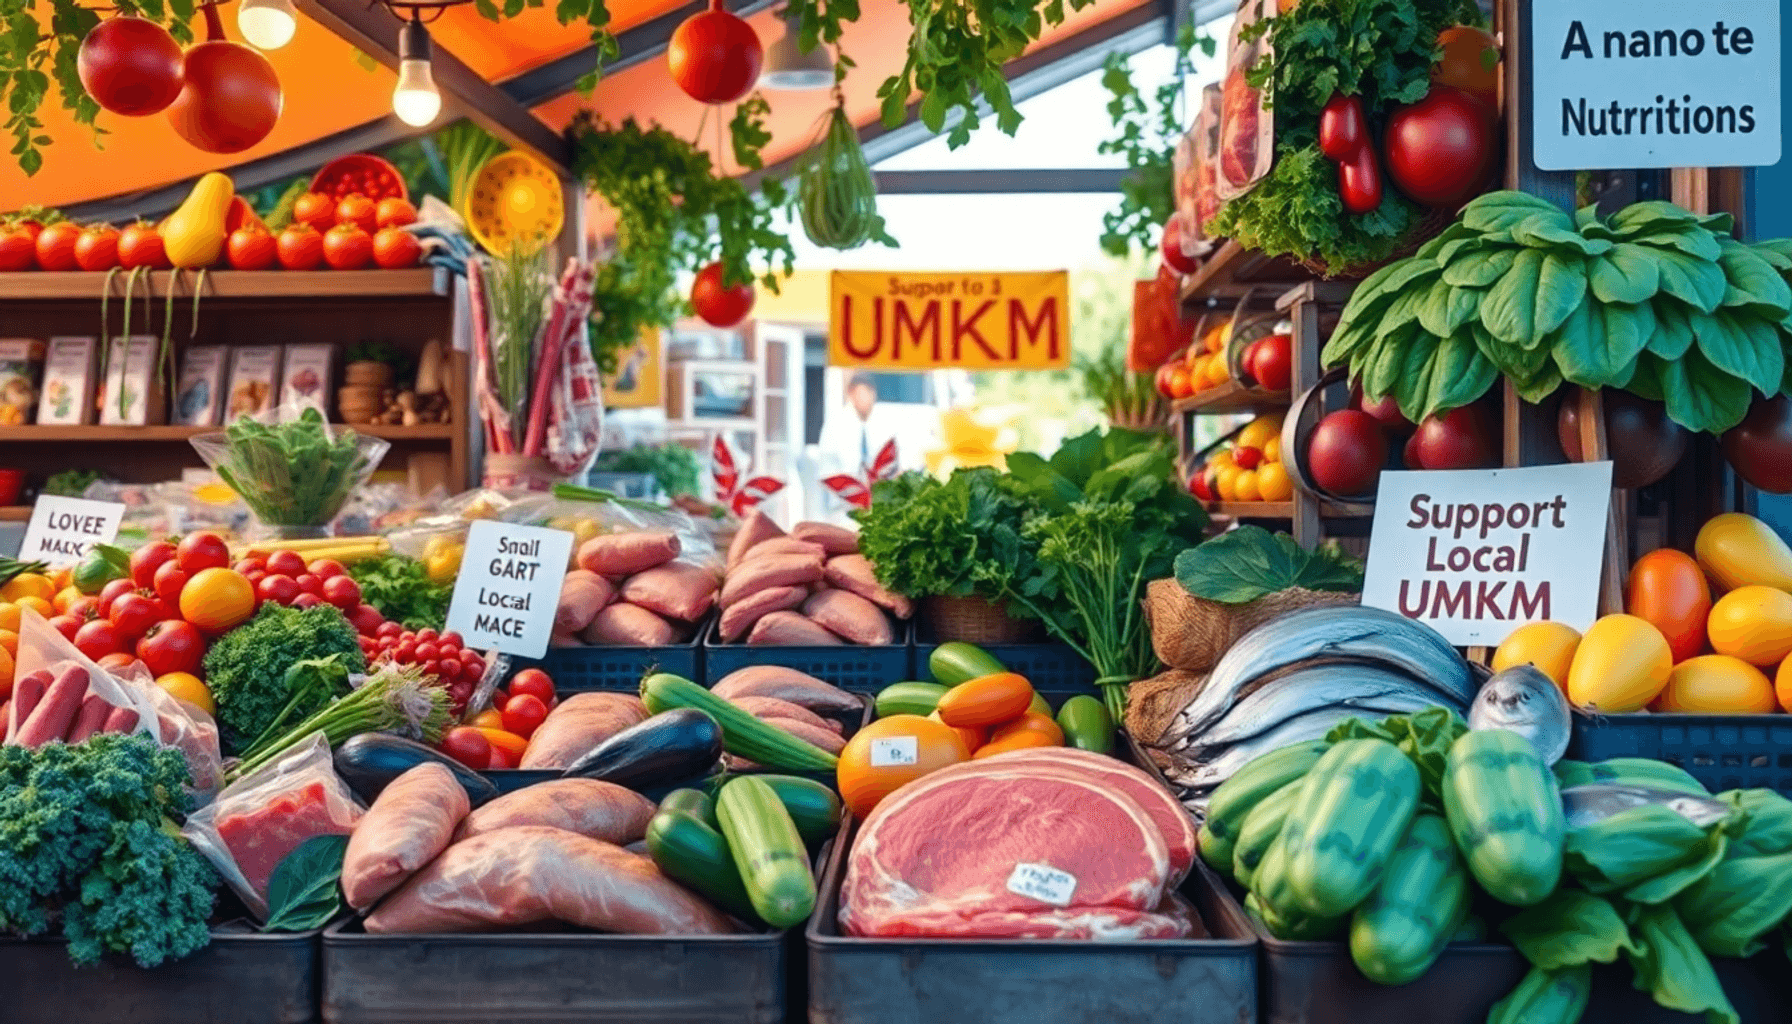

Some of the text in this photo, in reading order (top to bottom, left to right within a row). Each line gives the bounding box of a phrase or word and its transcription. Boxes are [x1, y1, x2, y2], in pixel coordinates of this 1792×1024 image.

[1560, 20, 1594, 60] A
[1561, 94, 1756, 136] Nutrritions
[841, 294, 1059, 361] UMKM
[1406, 493, 1567, 540] Support
[489, 558, 541, 581] GART
[1425, 533, 1531, 572] Local
[1398, 579, 1551, 621] UMKM
[474, 614, 525, 639] MACE
